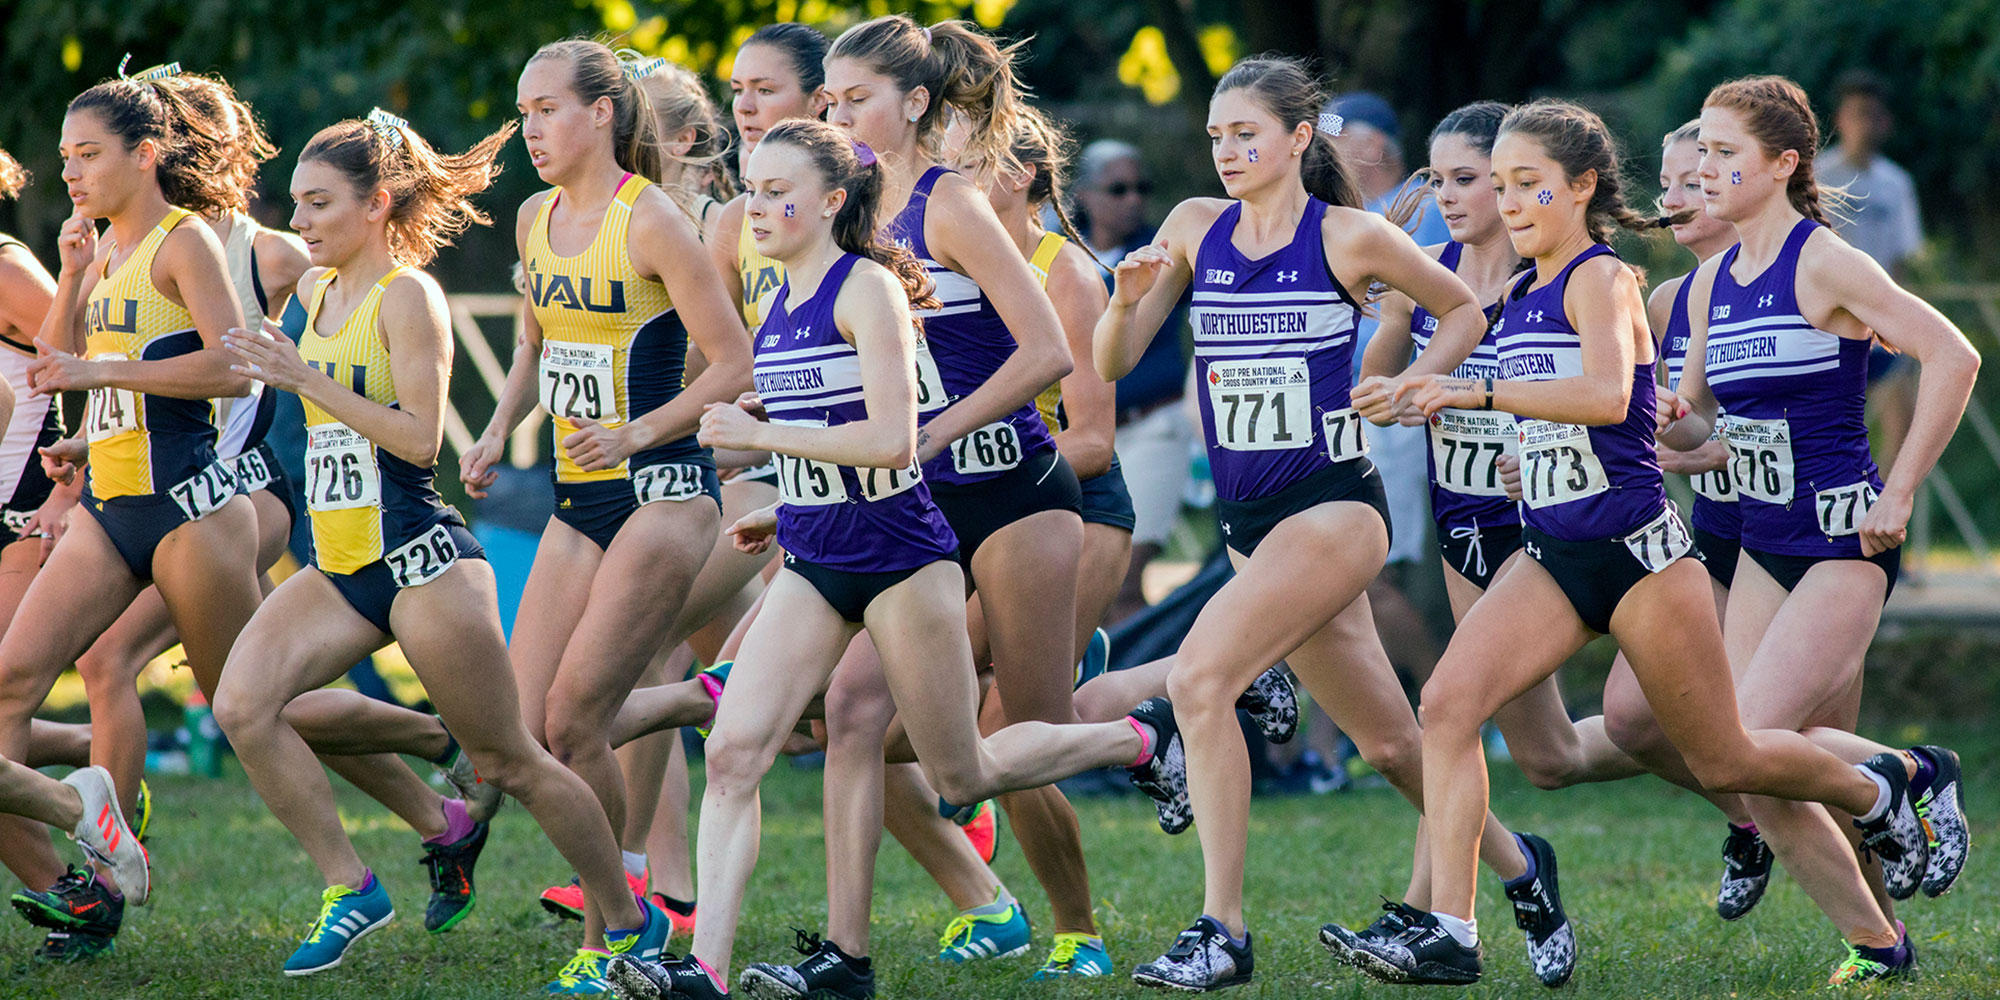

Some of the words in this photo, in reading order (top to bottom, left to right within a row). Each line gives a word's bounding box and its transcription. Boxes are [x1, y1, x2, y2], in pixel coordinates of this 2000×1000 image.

[528, 272, 627, 313] NAU
[1200, 311, 1307, 335] NORTHWESTERN
[569, 349, 597, 359] NATIONAL
[582, 360, 597, 368] MEET
[1222, 368, 1236, 377] 2017
[1238, 368, 1251, 377] PRE
[1252, 366, 1287, 376] NATIONAL
[547, 370, 601, 420] 729
[1223, 378, 1240, 387] CROSS
[1242, 377, 1268, 386] COUNTRY
[1270, 376, 1287, 385] MEET
[1222, 392, 1292, 443] 771
[1443, 423, 1459, 433] CROSS
[1460, 426, 1482, 435] COUNTRY
[1483, 428, 1499, 436] MEET
[1456, 415, 1466, 425] PRE
[1467, 417, 1500, 427] NATIONAL
[339, 438, 353, 447] MEET
[958, 427, 1018, 470] 768
[1758, 435, 1771, 444] MEET
[233, 453, 267, 485] 46
[310, 452, 363, 504] 726
[1442, 437, 1504, 488] 777
[1526, 446, 1589, 501] 773
[1729, 444, 1781, 497] 776
[173, 461, 237, 519] 724
[638, 464, 699, 502] 729
[388, 530, 455, 586] 726
